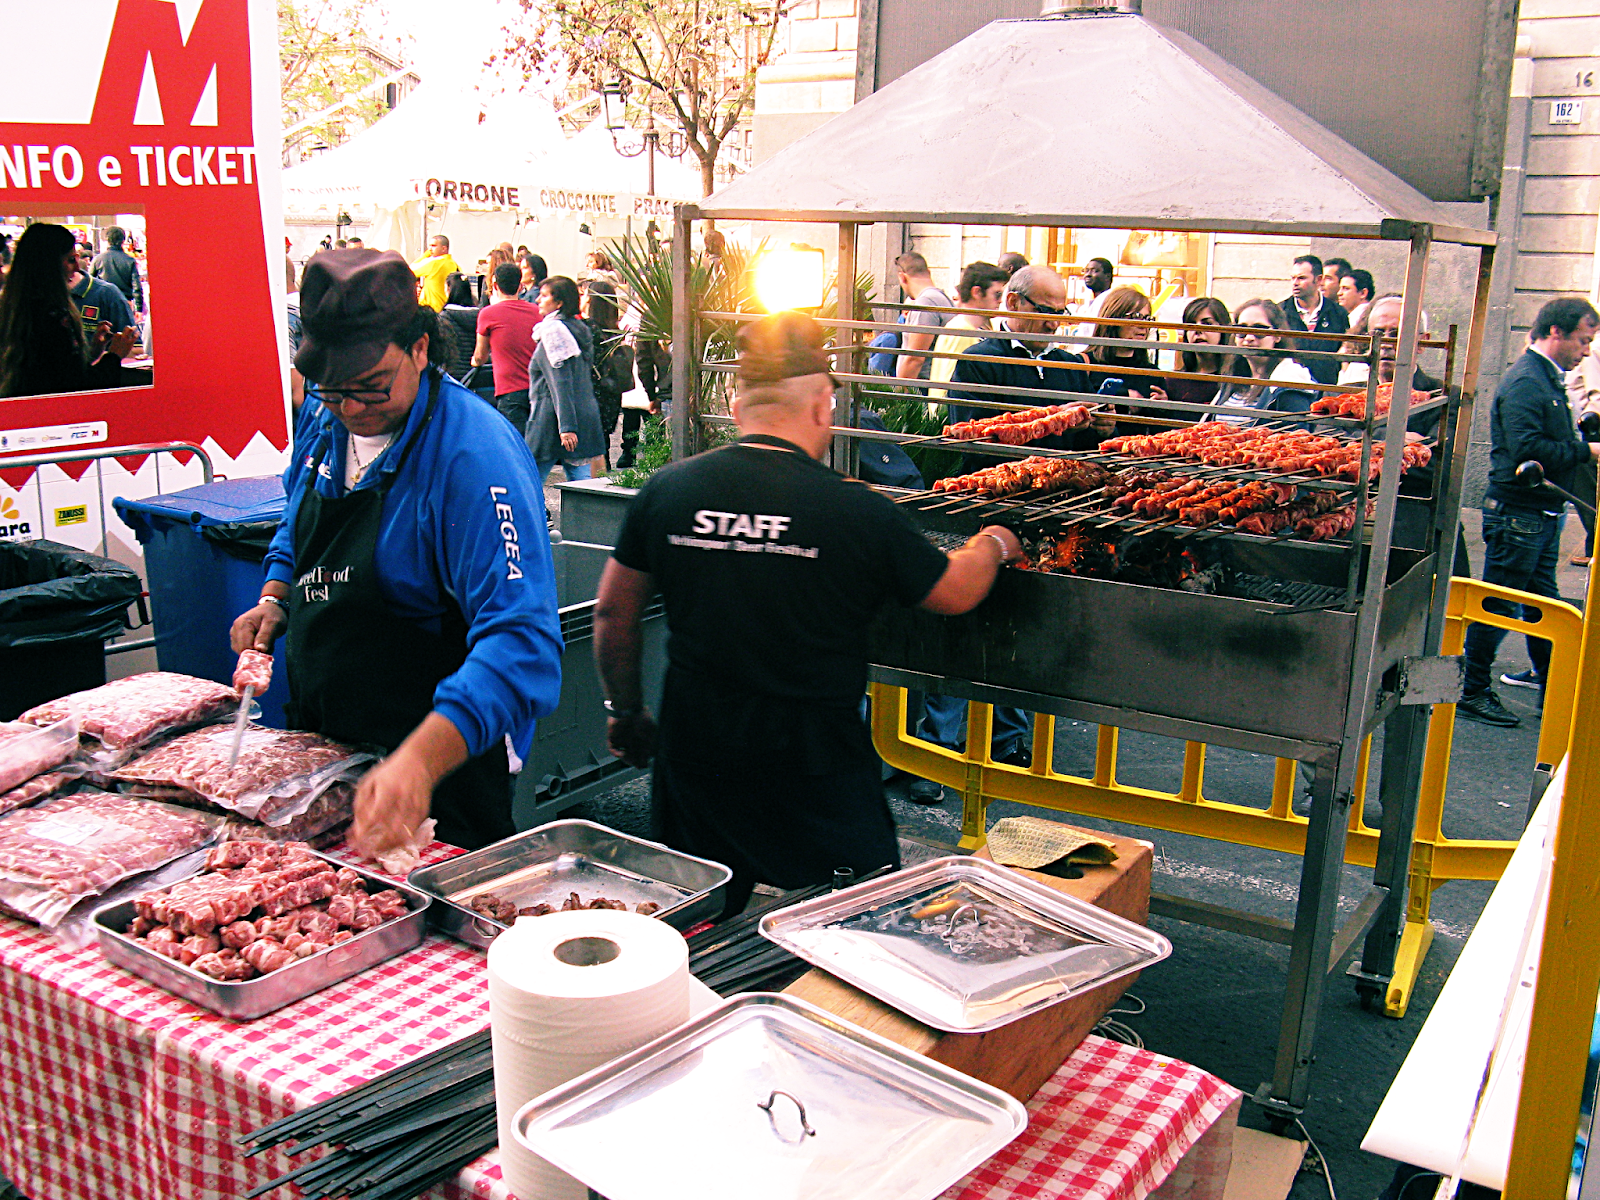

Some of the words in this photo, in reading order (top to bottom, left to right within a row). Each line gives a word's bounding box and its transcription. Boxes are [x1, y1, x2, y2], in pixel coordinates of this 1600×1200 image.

[1576, 71, 1594, 88] 16
[1556, 102, 1573, 117] 162
[98, 155, 122, 188] e
[130, 146, 256, 187] TICKET
[539, 189, 616, 213] CROCCANTE
[489, 485, 524, 580] LEGEA
[692, 509, 792, 540] STAFF
